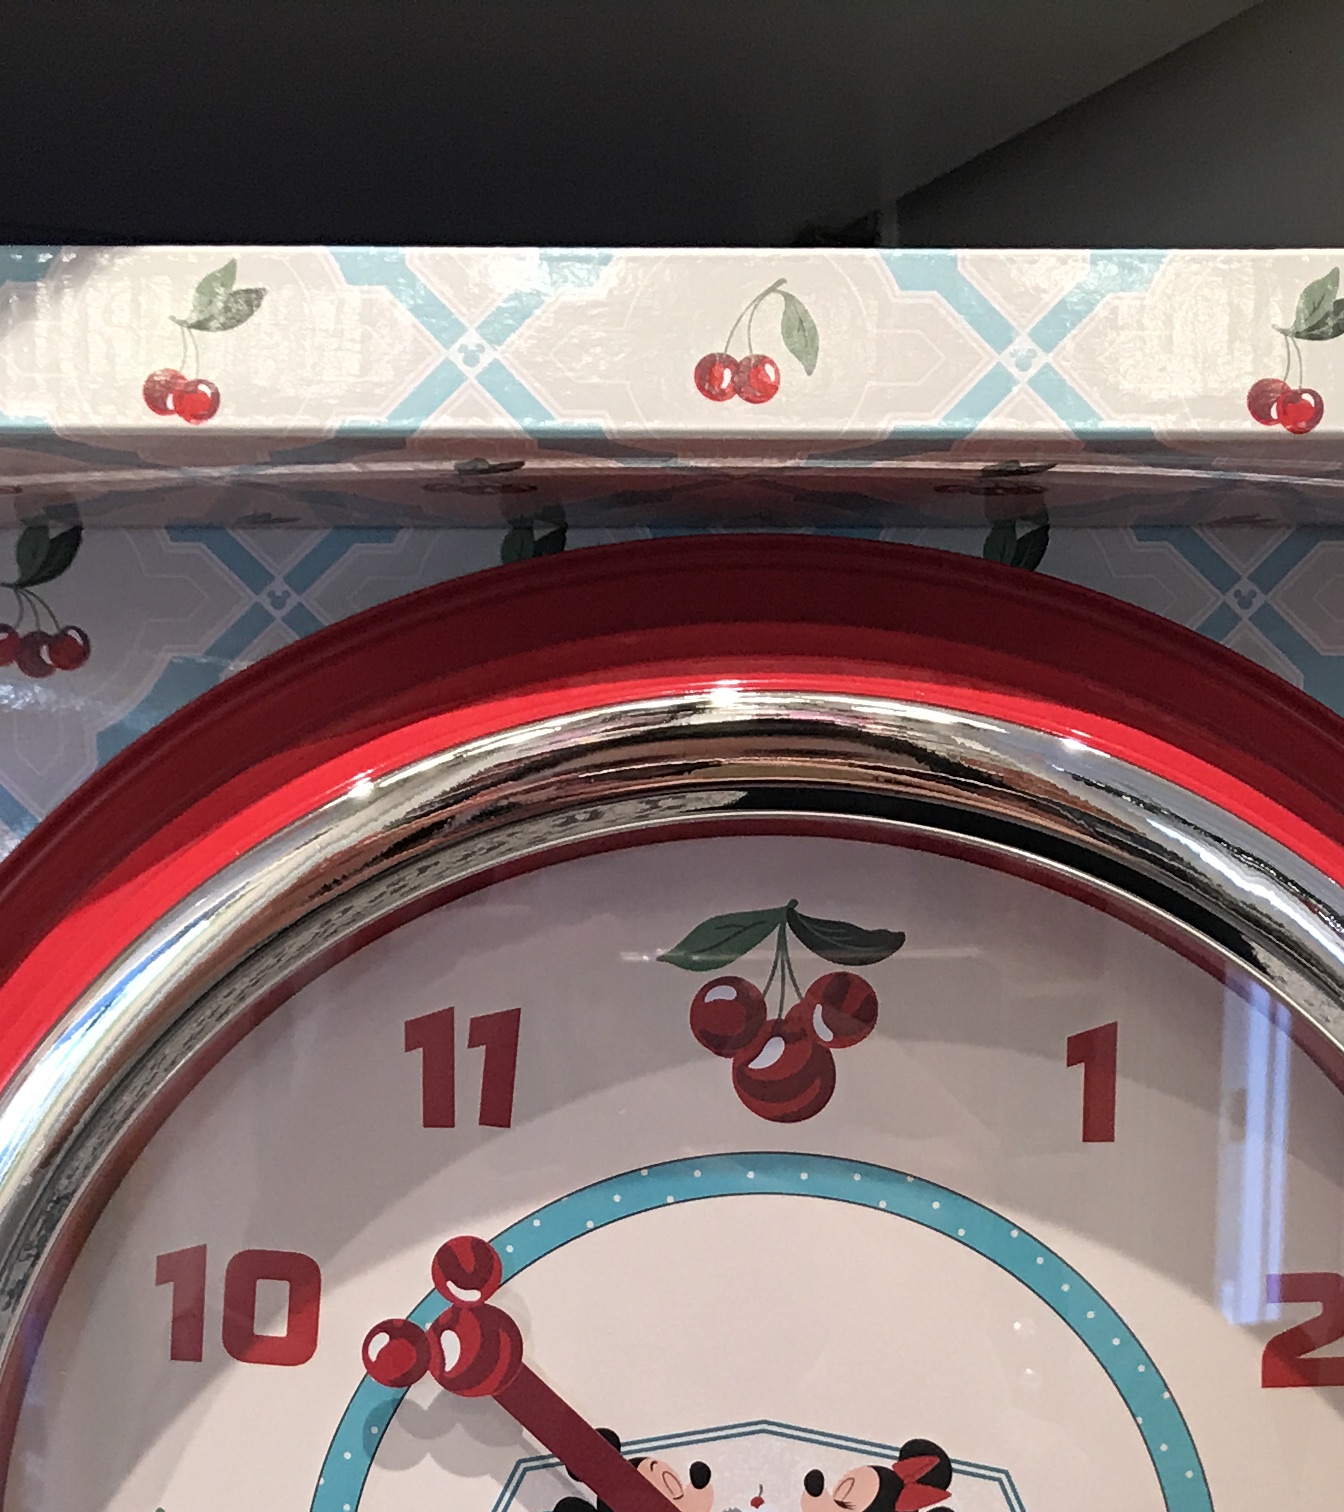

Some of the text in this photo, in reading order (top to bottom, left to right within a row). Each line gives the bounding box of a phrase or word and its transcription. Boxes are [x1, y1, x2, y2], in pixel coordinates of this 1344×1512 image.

[404, 1006, 522, 1129] 11
[1066, 1021, 1118, 1143] 1
[155, 1243, 322, 1367] 10
